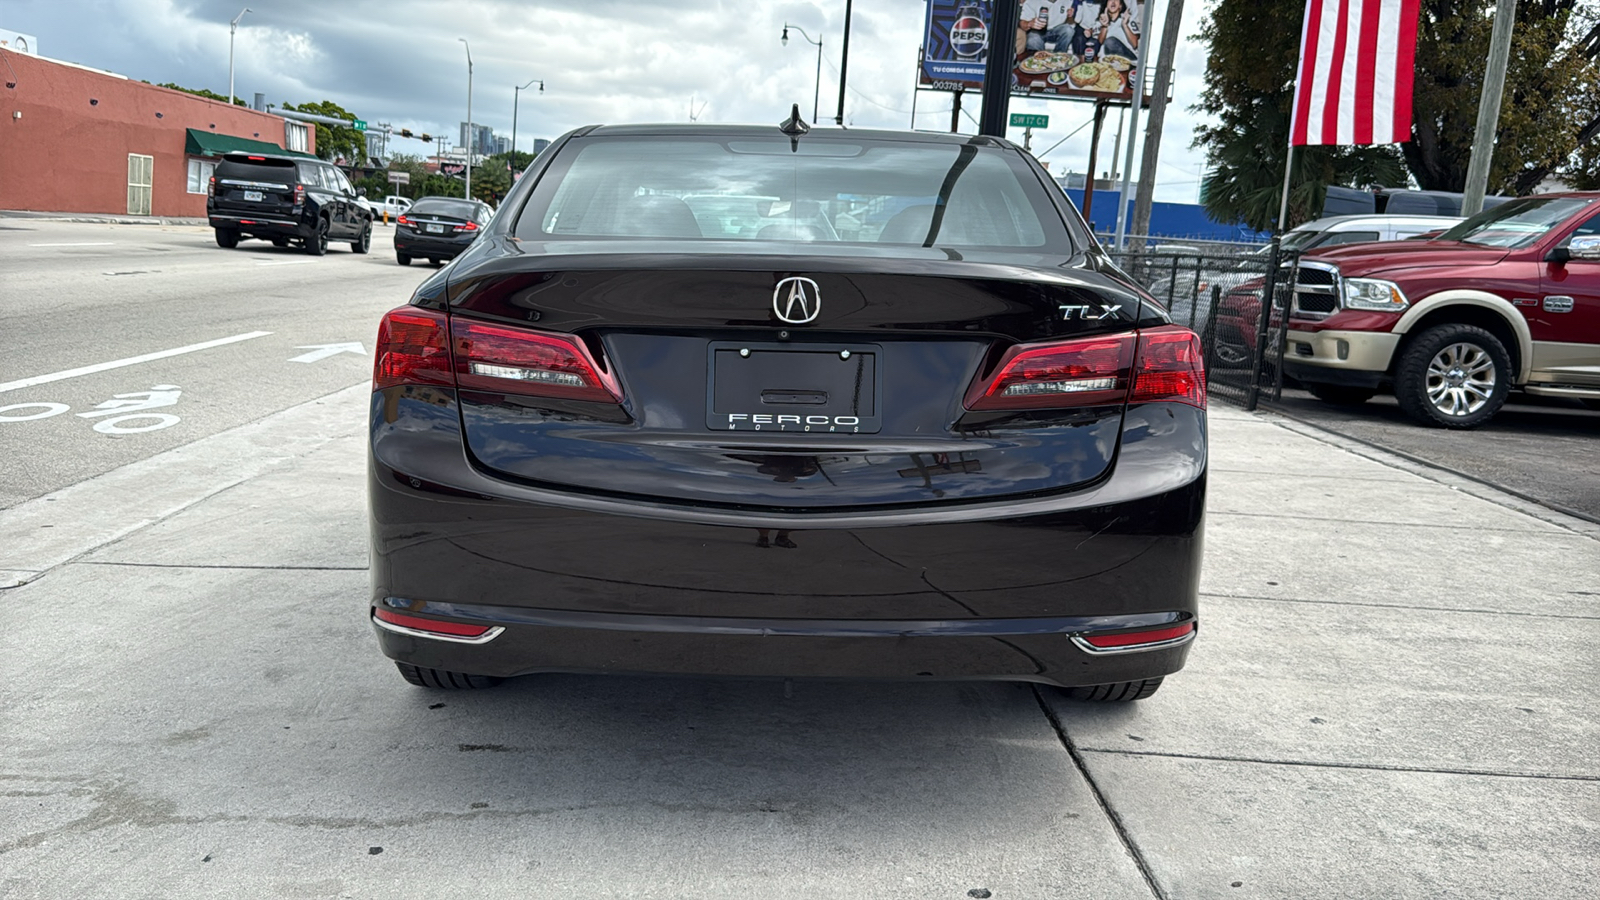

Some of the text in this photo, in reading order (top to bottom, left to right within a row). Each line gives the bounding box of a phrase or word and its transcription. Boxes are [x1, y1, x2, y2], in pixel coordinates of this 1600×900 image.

[952, 31, 986, 41] PEPSI
[942, 66, 965, 74] COMIDA
[933, 80, 963, 91] 003785
[1013, 116, 1046, 126] SW 17 Ct
[1058, 304, 1122, 321] TLX
[728, 413, 860, 425] FERCO
[728, 424, 859, 433] MOTORS
